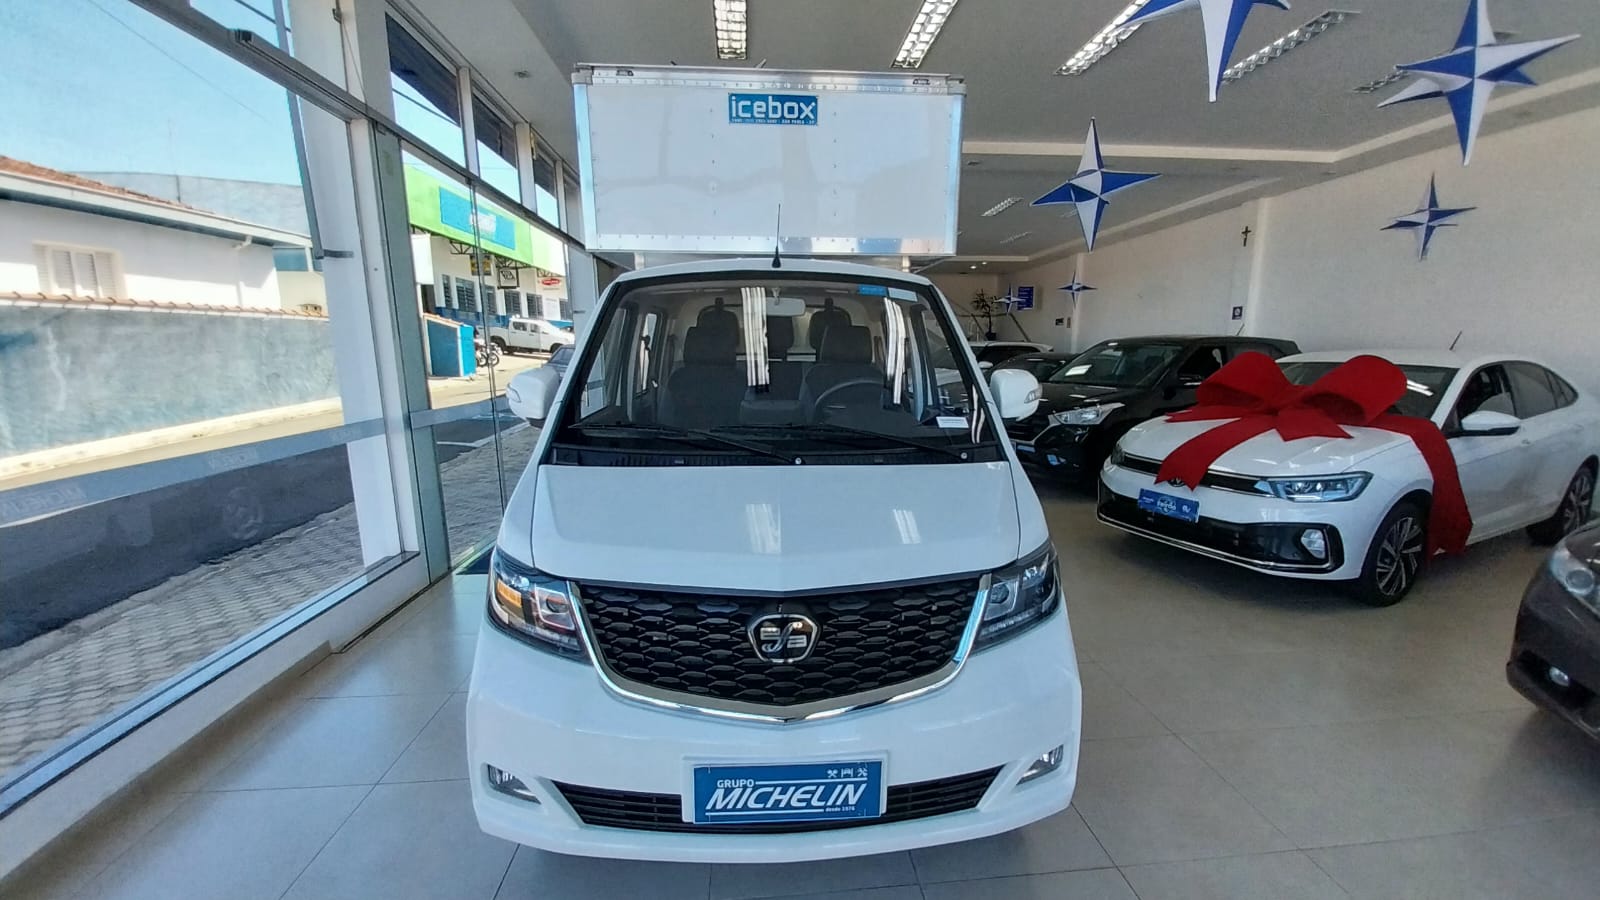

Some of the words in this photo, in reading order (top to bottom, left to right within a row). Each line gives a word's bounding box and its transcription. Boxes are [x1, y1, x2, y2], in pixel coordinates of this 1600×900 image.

[731, 95, 816, 119] icebox
[717, 779, 754, 788] GRUPO
[705, 783, 867, 810] MICHELIN
